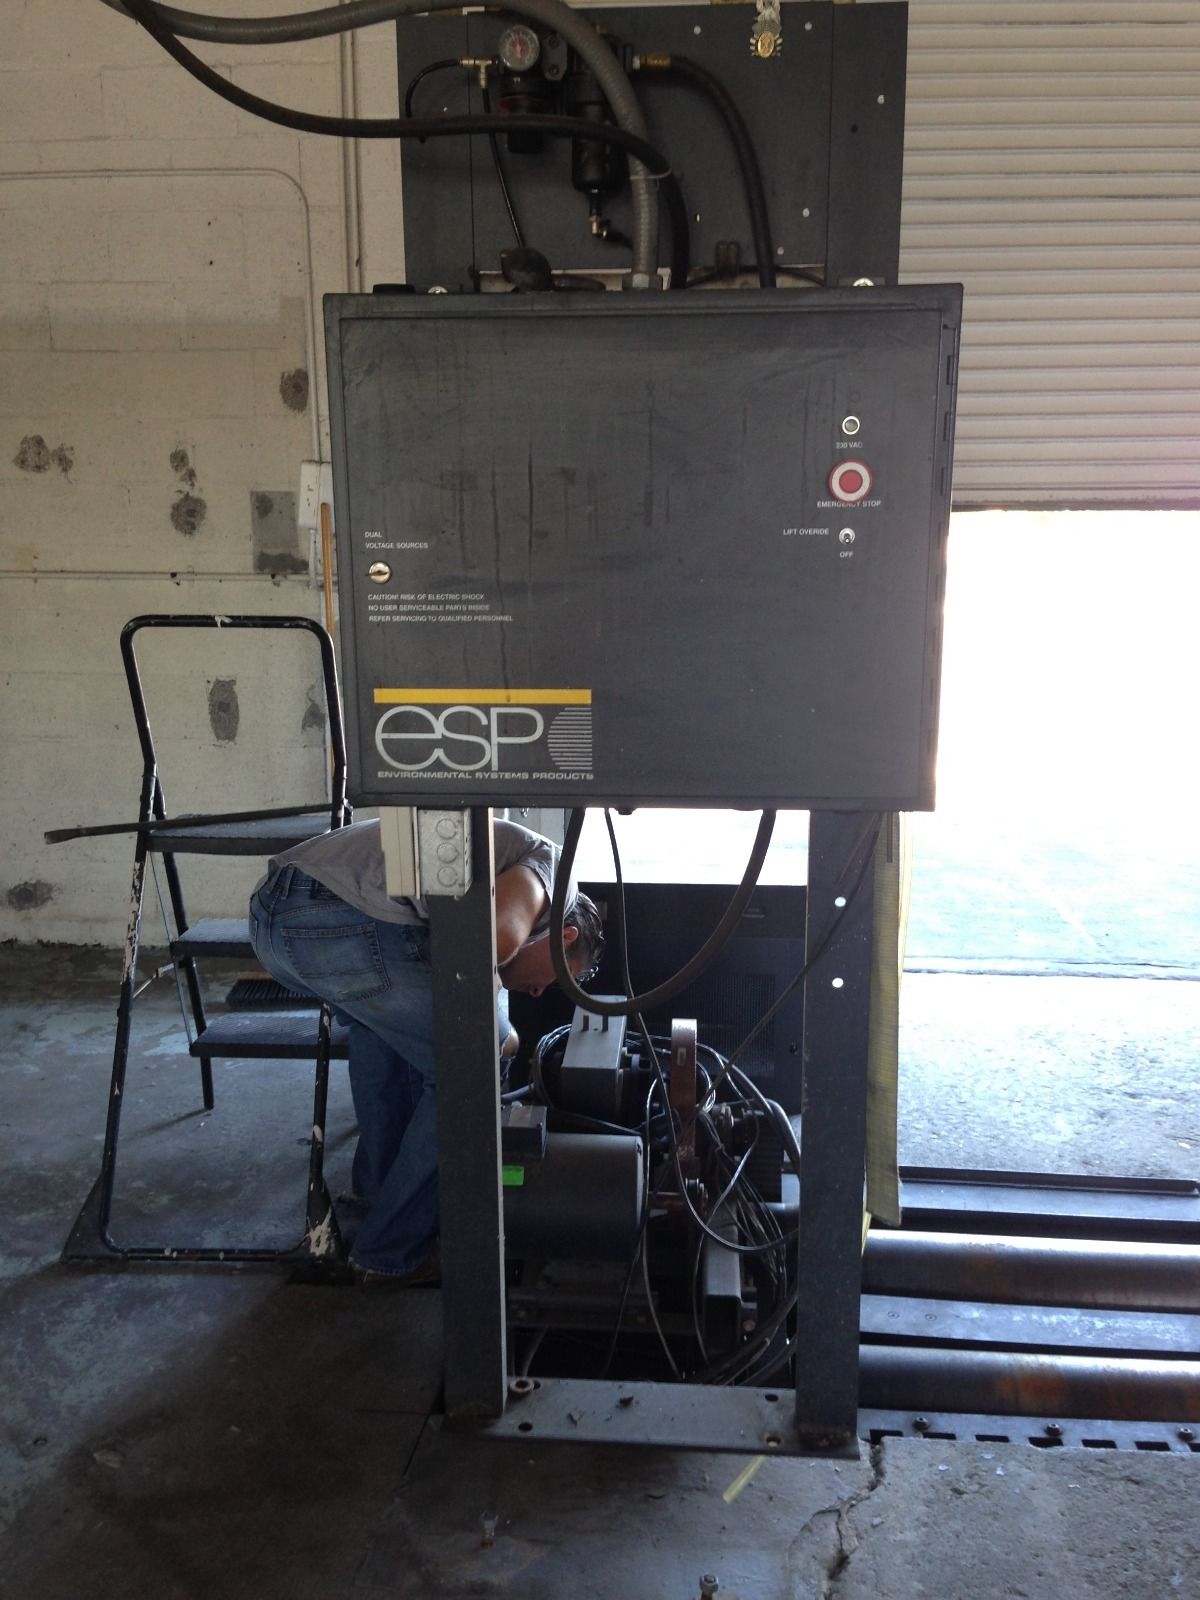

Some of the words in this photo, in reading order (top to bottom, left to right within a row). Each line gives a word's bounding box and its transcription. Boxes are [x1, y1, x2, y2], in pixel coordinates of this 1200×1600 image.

[862, 500, 881, 508] STOP
[783, 528, 798, 536] LIFT
[840, 550, 853, 558] OFF
[417, 593, 427, 601] OF
[428, 593, 461, 601] ELECTRIC
[368, 604, 379, 612] NO
[379, 604, 398, 612] USER
[377, 770, 472, 779] ENVIRONMENTAL
[475, 771, 530, 779] SYSTEMS
[532, 772, 594, 780] PRODUCTS
